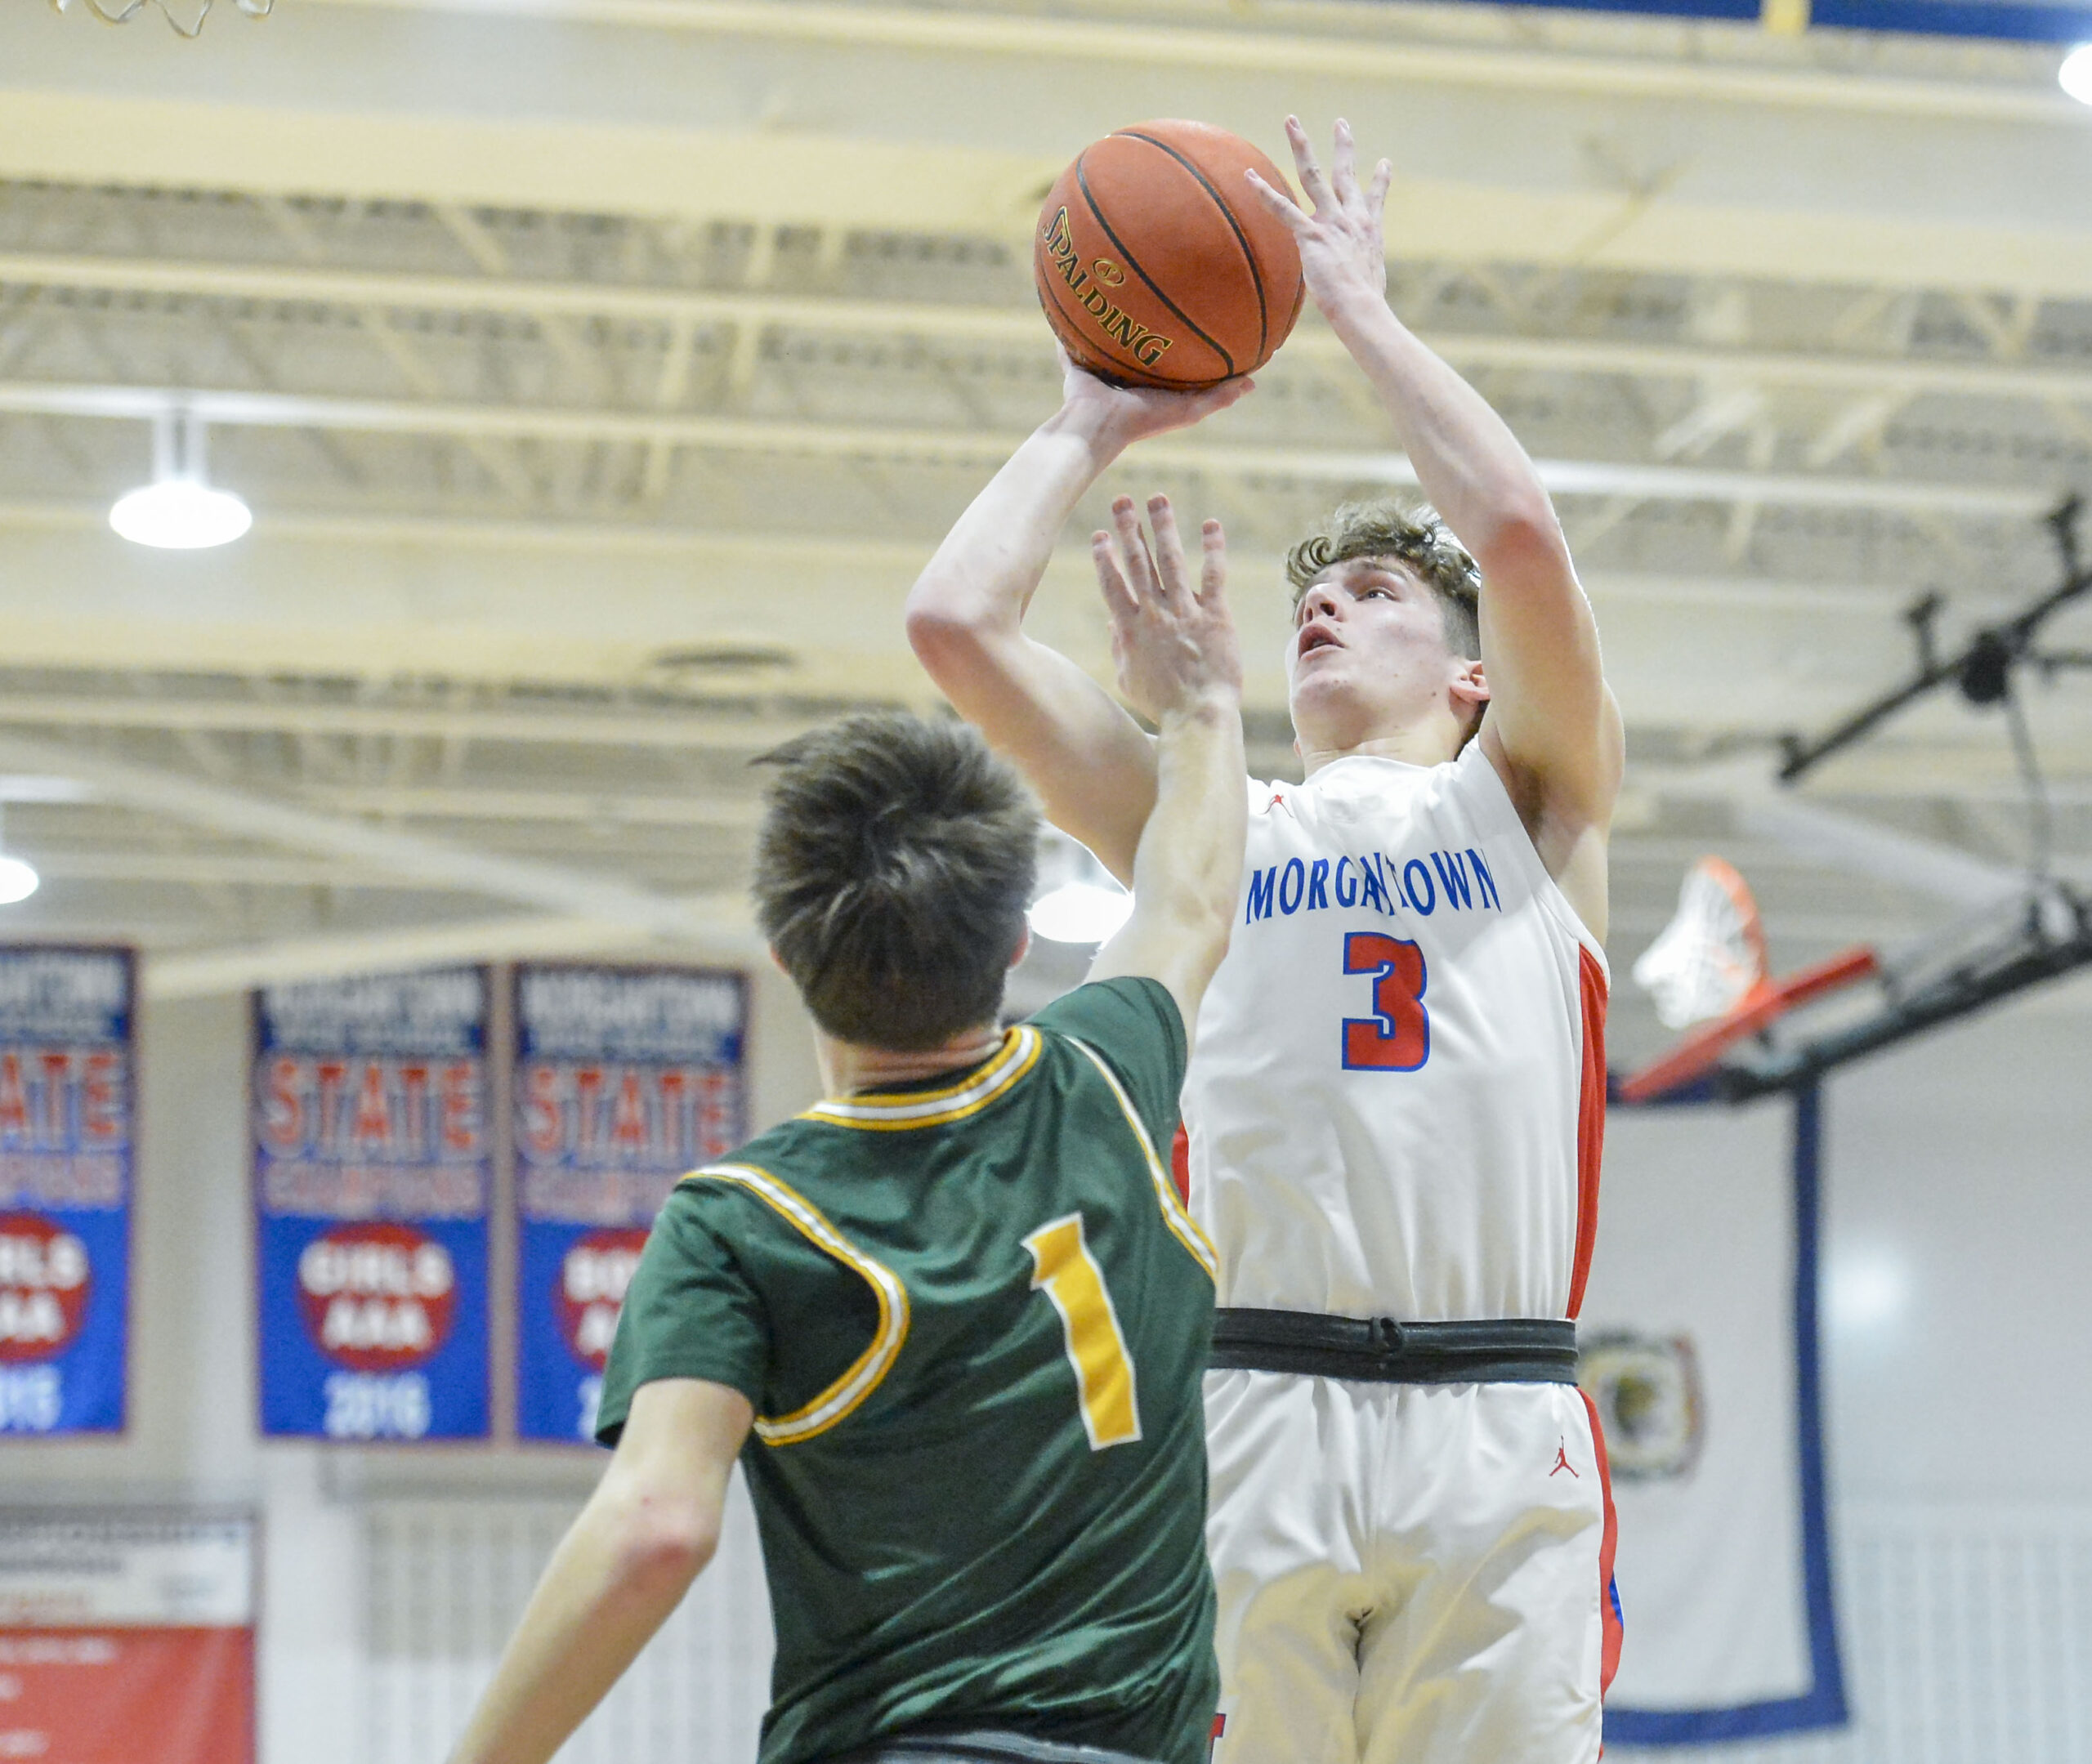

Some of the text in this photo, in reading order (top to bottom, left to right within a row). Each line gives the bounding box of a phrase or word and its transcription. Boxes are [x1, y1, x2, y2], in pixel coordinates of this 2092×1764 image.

[1042, 205, 1173, 368] SPALDING
[1341, 931, 1431, 1073] 3
[0, 1053, 121, 1145] ATE
[263, 1056, 482, 1155] STATE
[525, 1065, 731, 1159] STATE
[298, 1241, 454, 1297] GIRLS
[321, 1297, 431, 1351] AAA
[1020, 1210, 1143, 1452] 1
